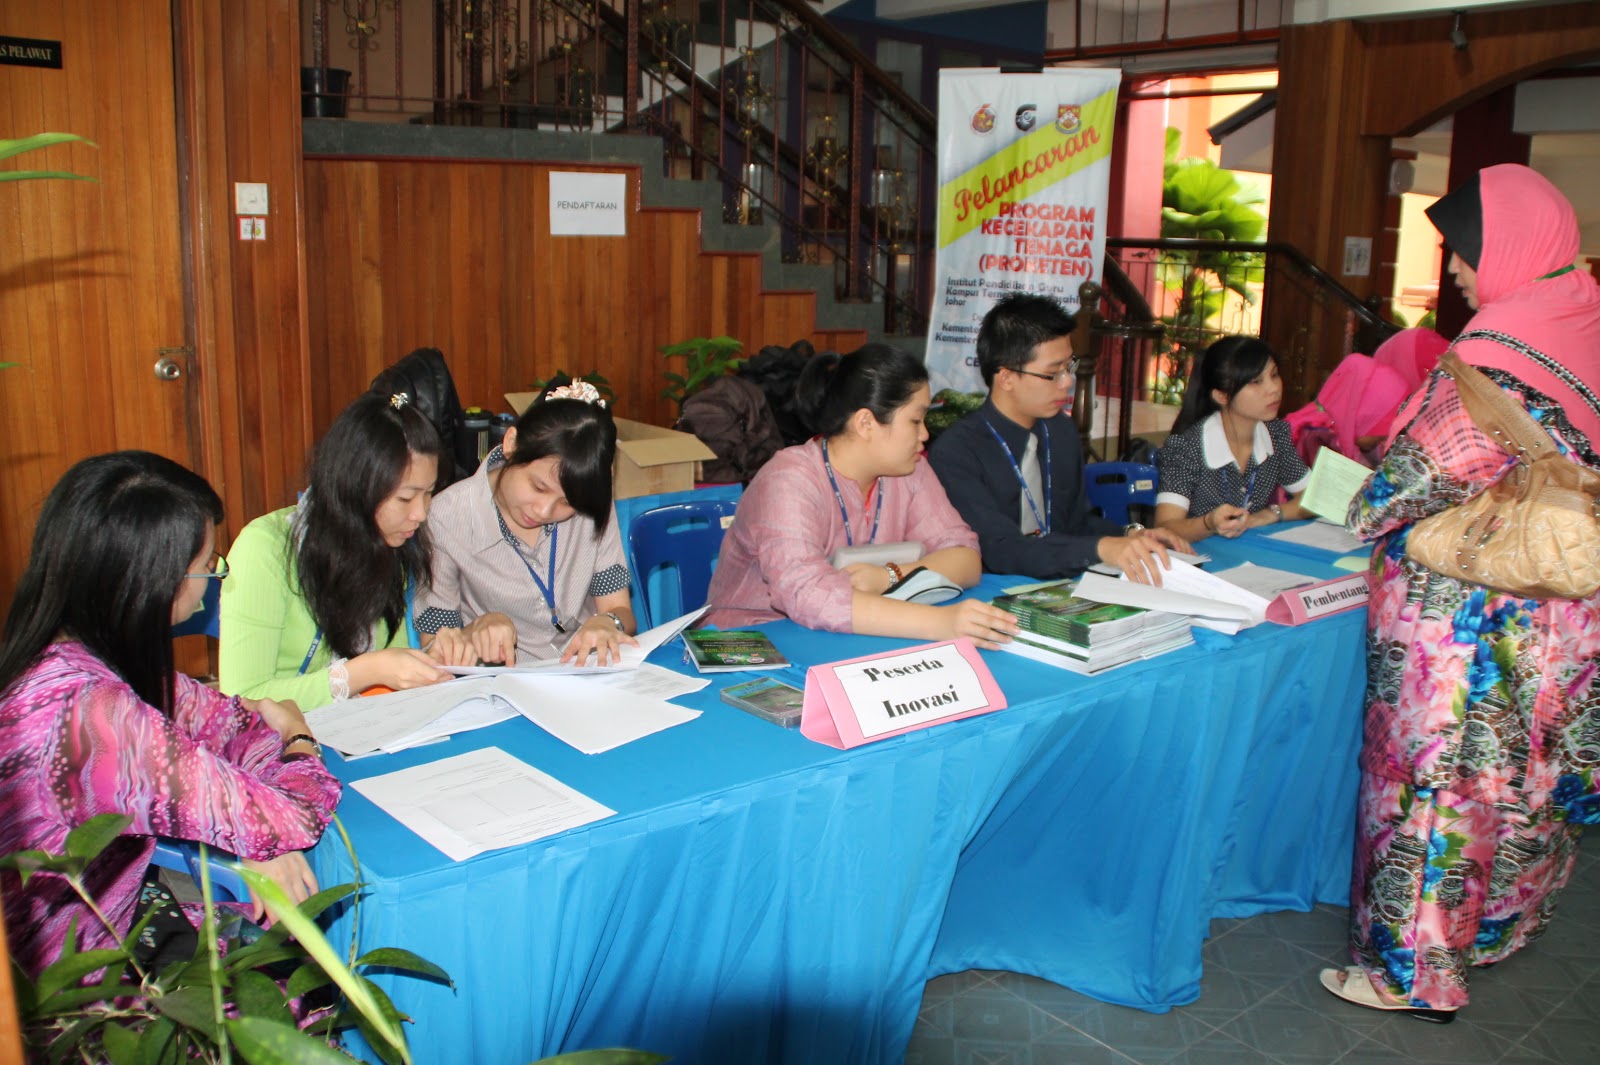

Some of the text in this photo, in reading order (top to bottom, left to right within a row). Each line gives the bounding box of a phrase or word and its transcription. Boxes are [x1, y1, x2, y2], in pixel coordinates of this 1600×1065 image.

[9, 45, 52, 60] PELAWAT
[954, 125, 1101, 222] Pelancaran
[557, 200, 617, 210] PENDAFTARAN
[999, 201, 1096, 223] PROGRAM
[981, 218, 1094, 241] KECEKAPAN
[1014, 238, 1092, 259] TENAGA
[979, 254, 1094, 282] (PROKETEN)
[946, 286, 979, 298] Kampus
[947, 276, 977, 287] Institut
[945, 297, 966, 306] Johor
[942, 322, 980, 333] Kemente
[1302, 583, 1370, 610] Pembentang
[863, 658, 944, 682] Peserta
[882, 684, 960, 718] Inovasi
